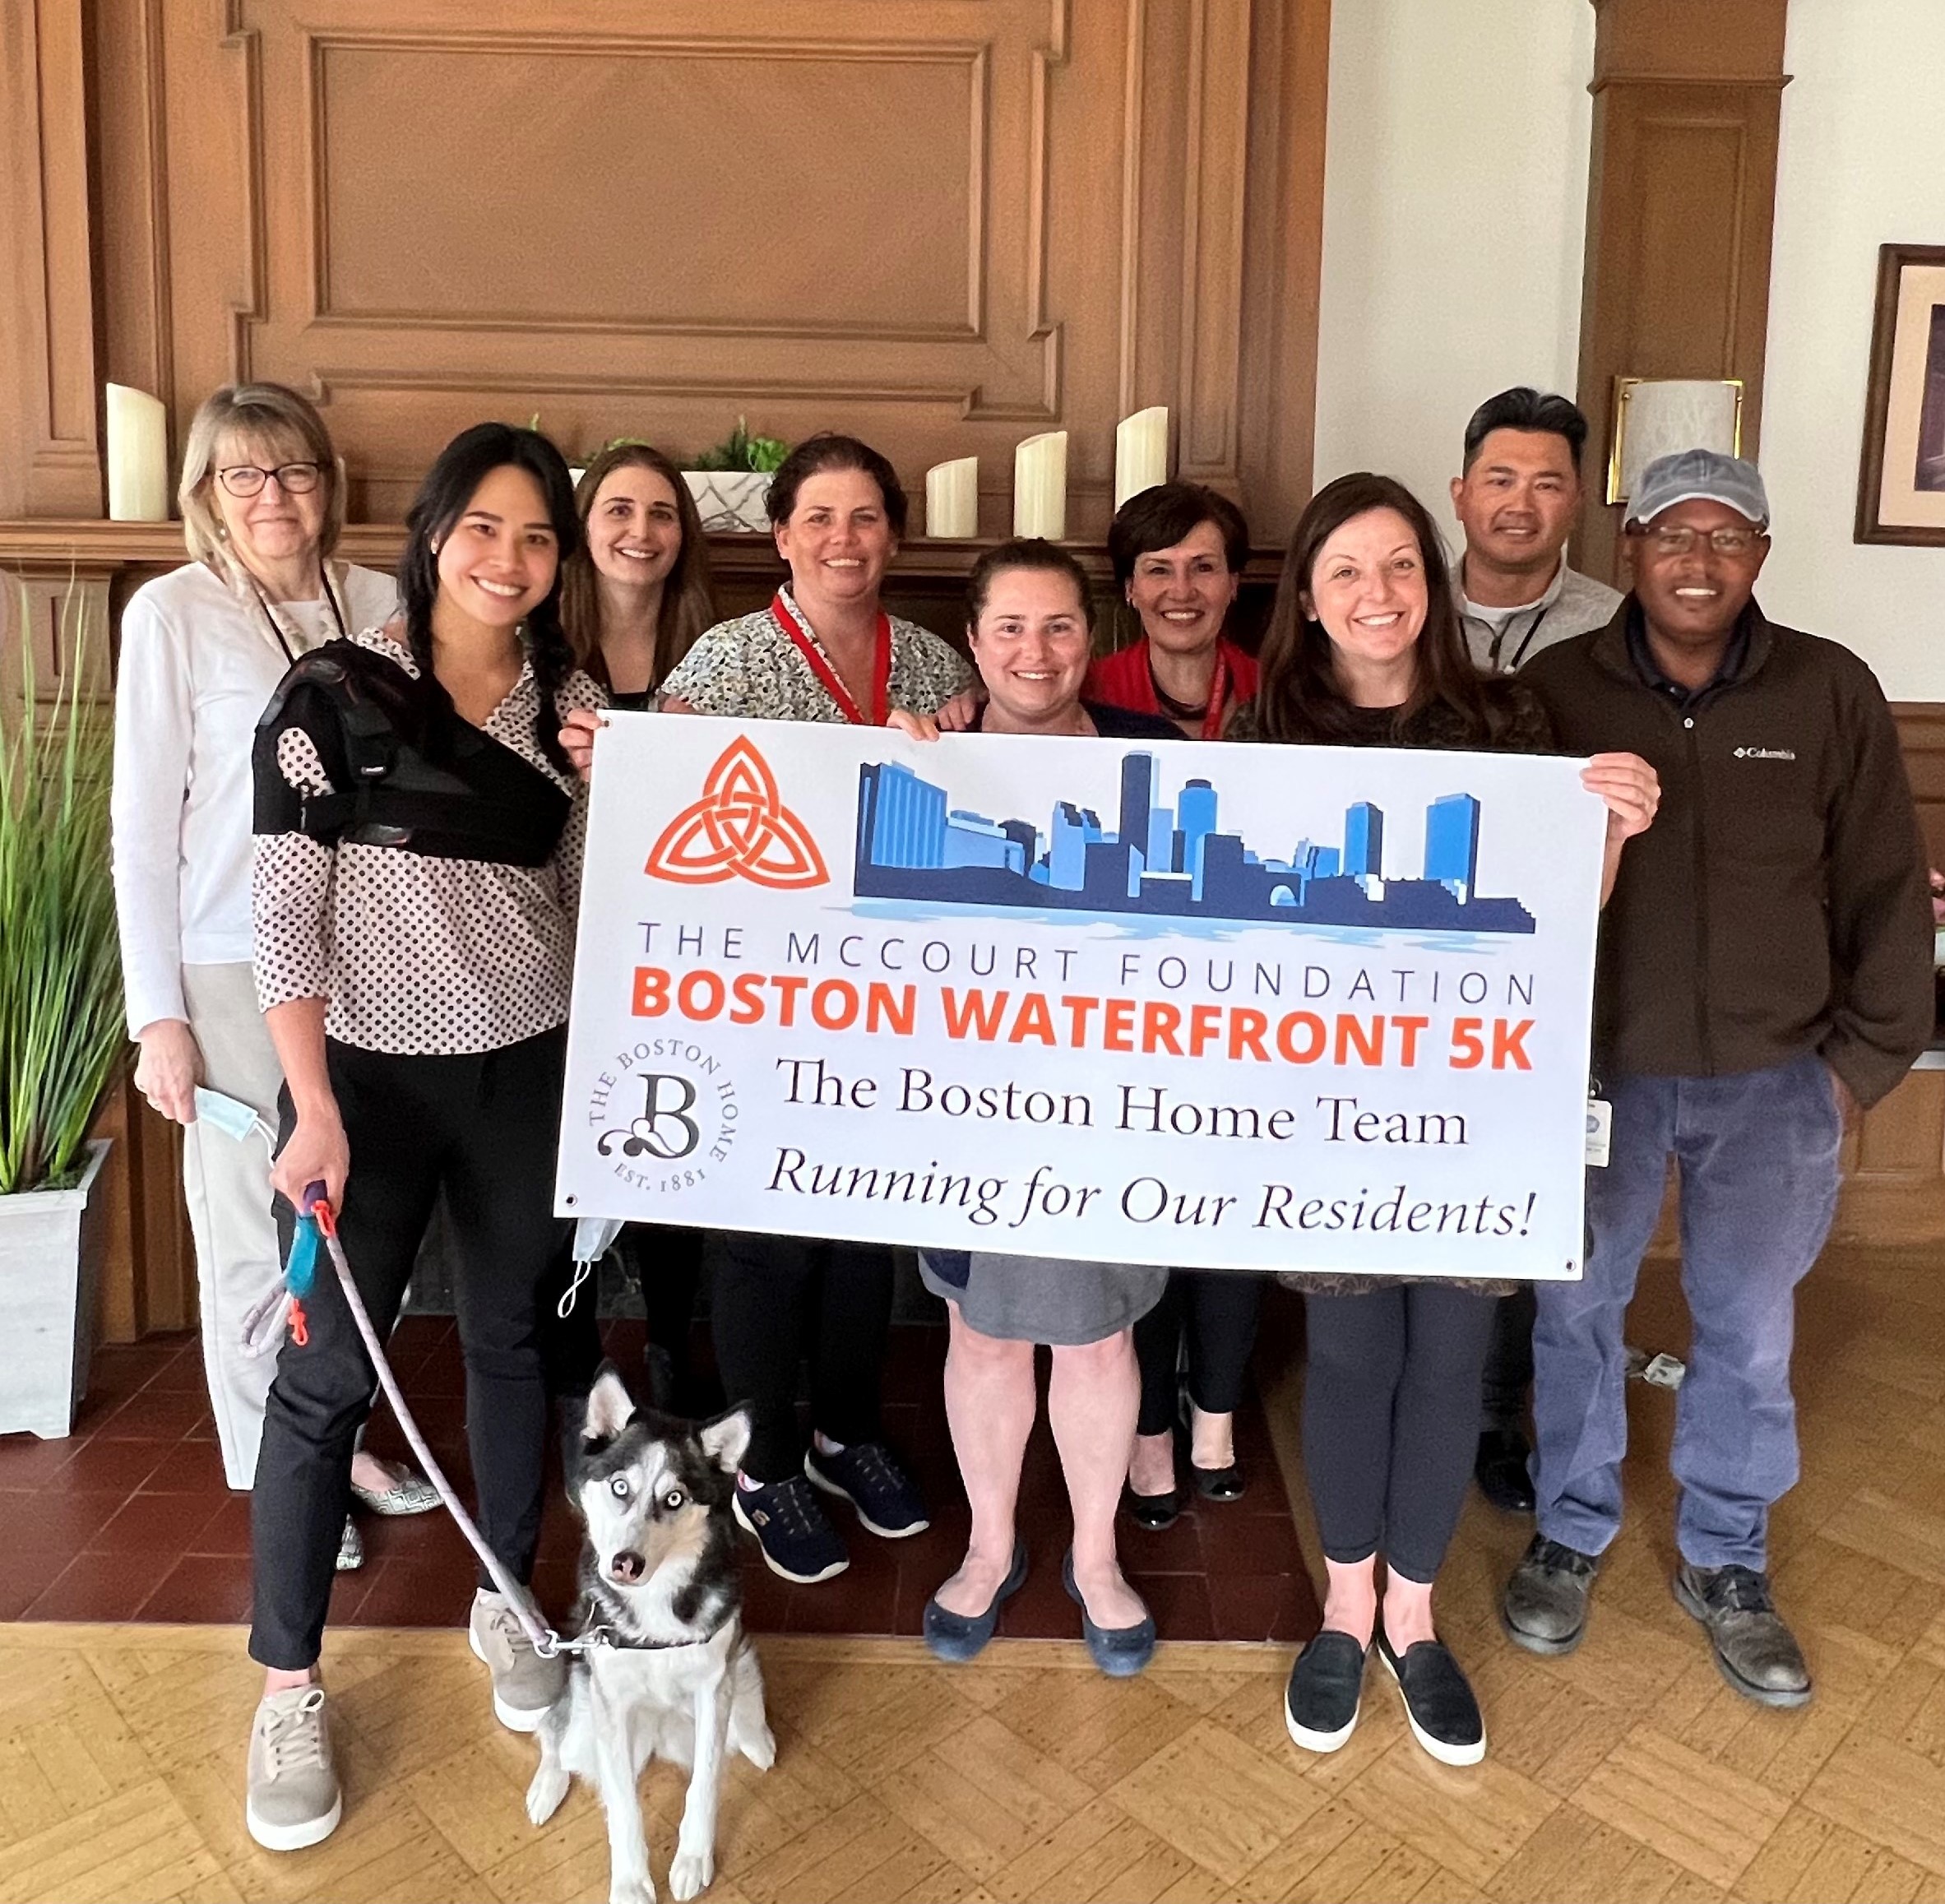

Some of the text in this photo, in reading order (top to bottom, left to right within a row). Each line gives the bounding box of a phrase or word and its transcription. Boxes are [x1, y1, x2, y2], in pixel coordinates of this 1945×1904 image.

[637, 921, 1535, 1005] THE MCCOURT FOUNDATION
[632, 966, 1535, 1070] BOSTON WATERFRONT 5K
[589, 1038, 739, 1163] THE BOSTON HOME
[776, 1057, 1469, 1146] The Boston Home Team
[614, 1162, 706, 1193] EST. 1881
[763, 1146, 1538, 1238] Running for Our Residents!
